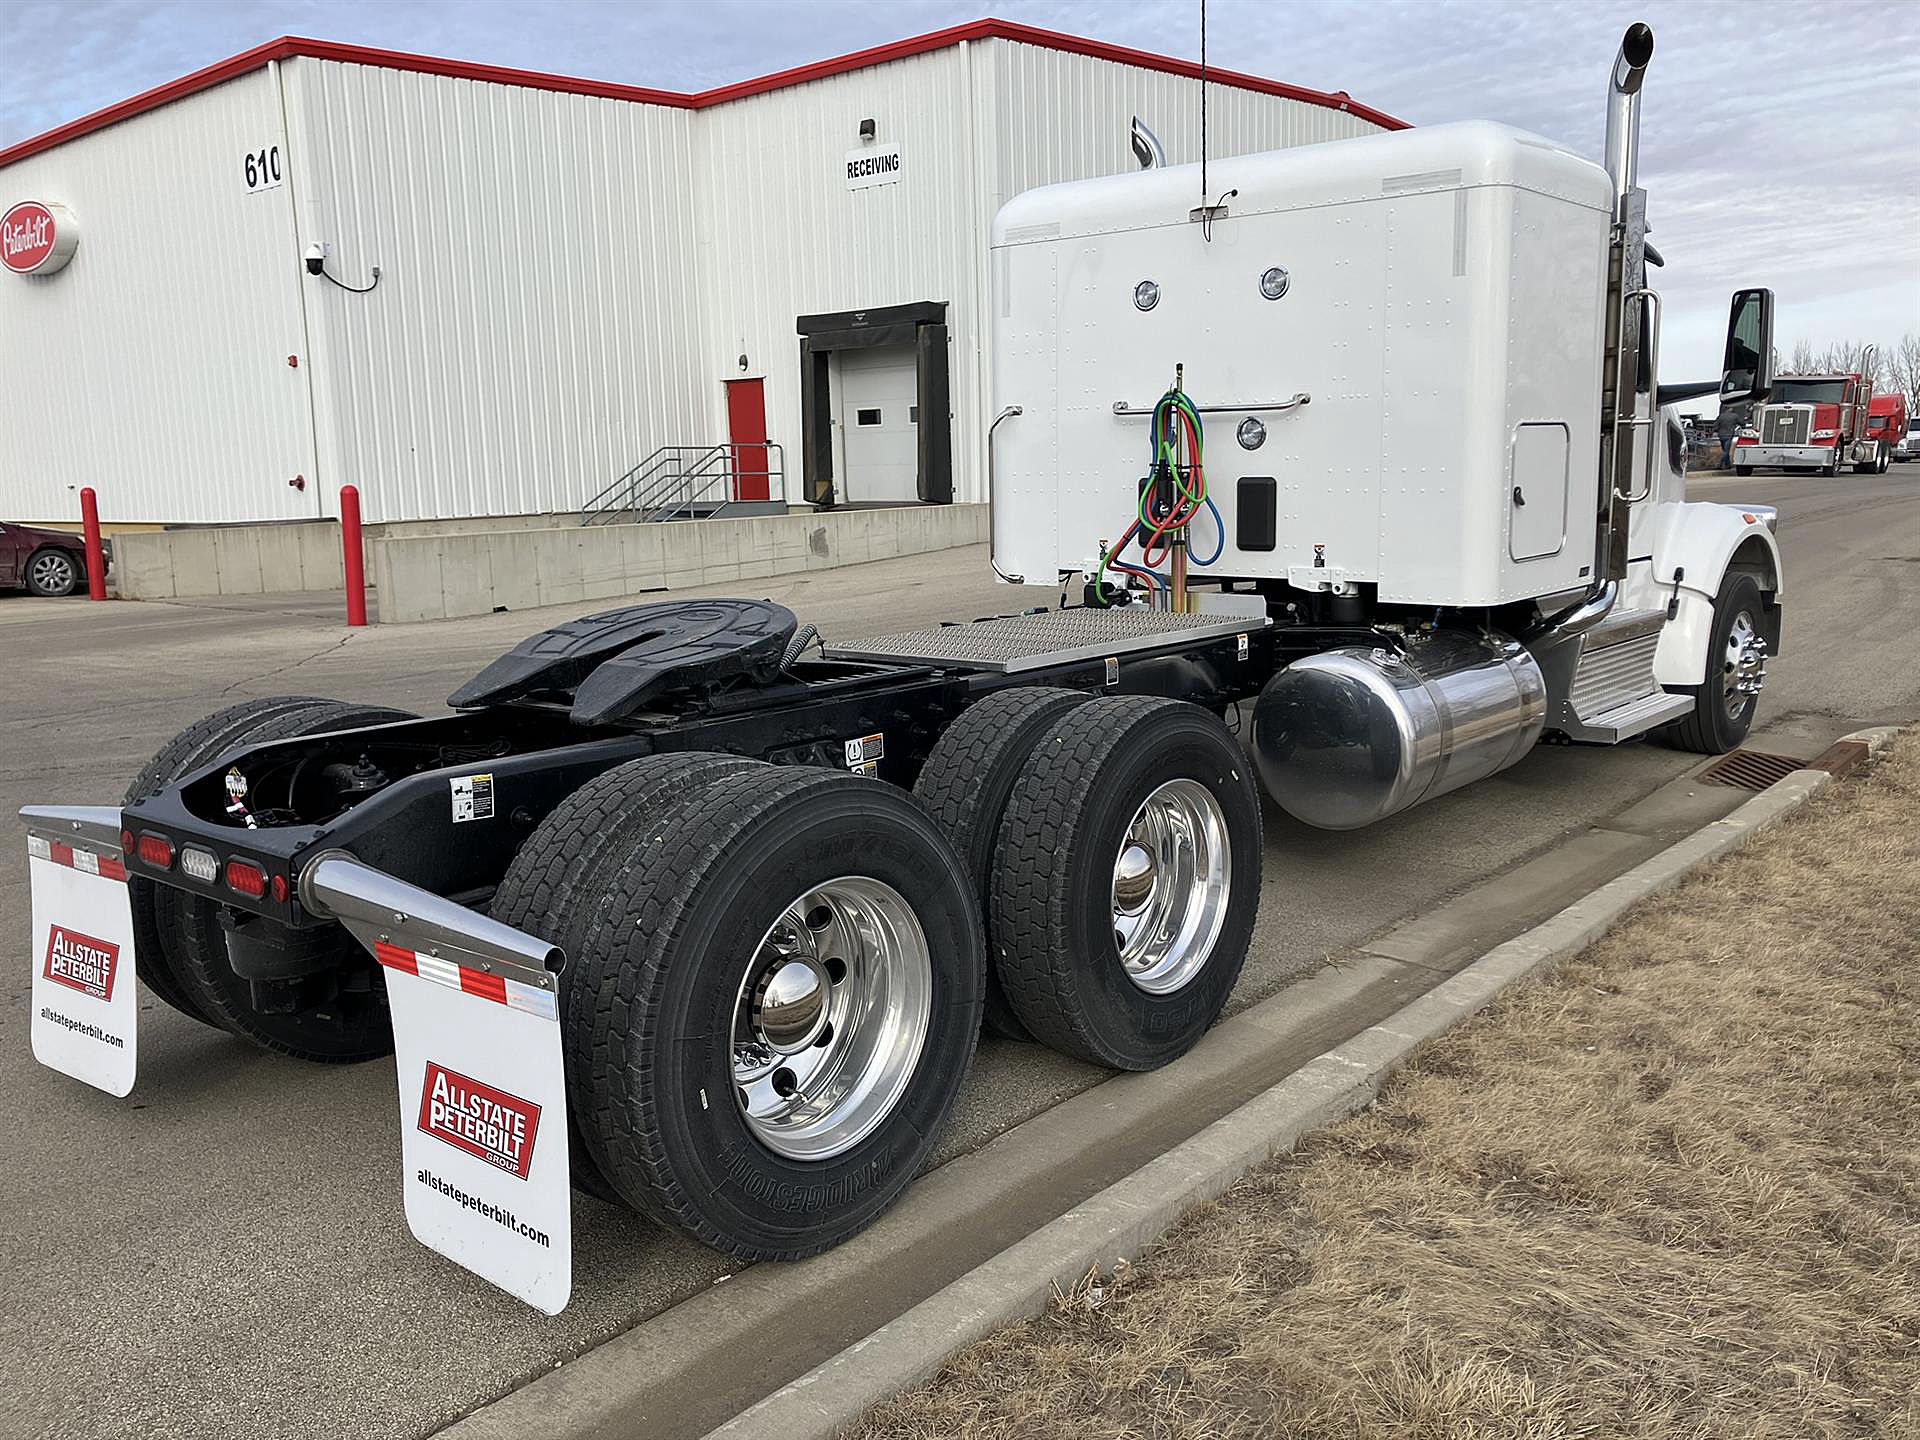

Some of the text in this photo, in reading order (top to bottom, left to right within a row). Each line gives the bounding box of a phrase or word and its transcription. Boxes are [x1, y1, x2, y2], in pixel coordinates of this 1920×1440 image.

[245, 146, 281, 188] 610
[847, 154, 899, 179] RECEIVING
[3, 216, 50, 260] Peterbilt
[51, 954, 109, 988] PETERBILT
[53, 931, 110, 970] ALLSTATE
[41, 1008, 124, 1048] allstatepeterbilt.com
[432, 1071, 527, 1138] ALLSTATE
[430, 1100, 524, 1160] PETERBILT
[485, 1152, 520, 1173] GROUP
[418, 1169, 550, 1248] allstatepeterbilt.com
